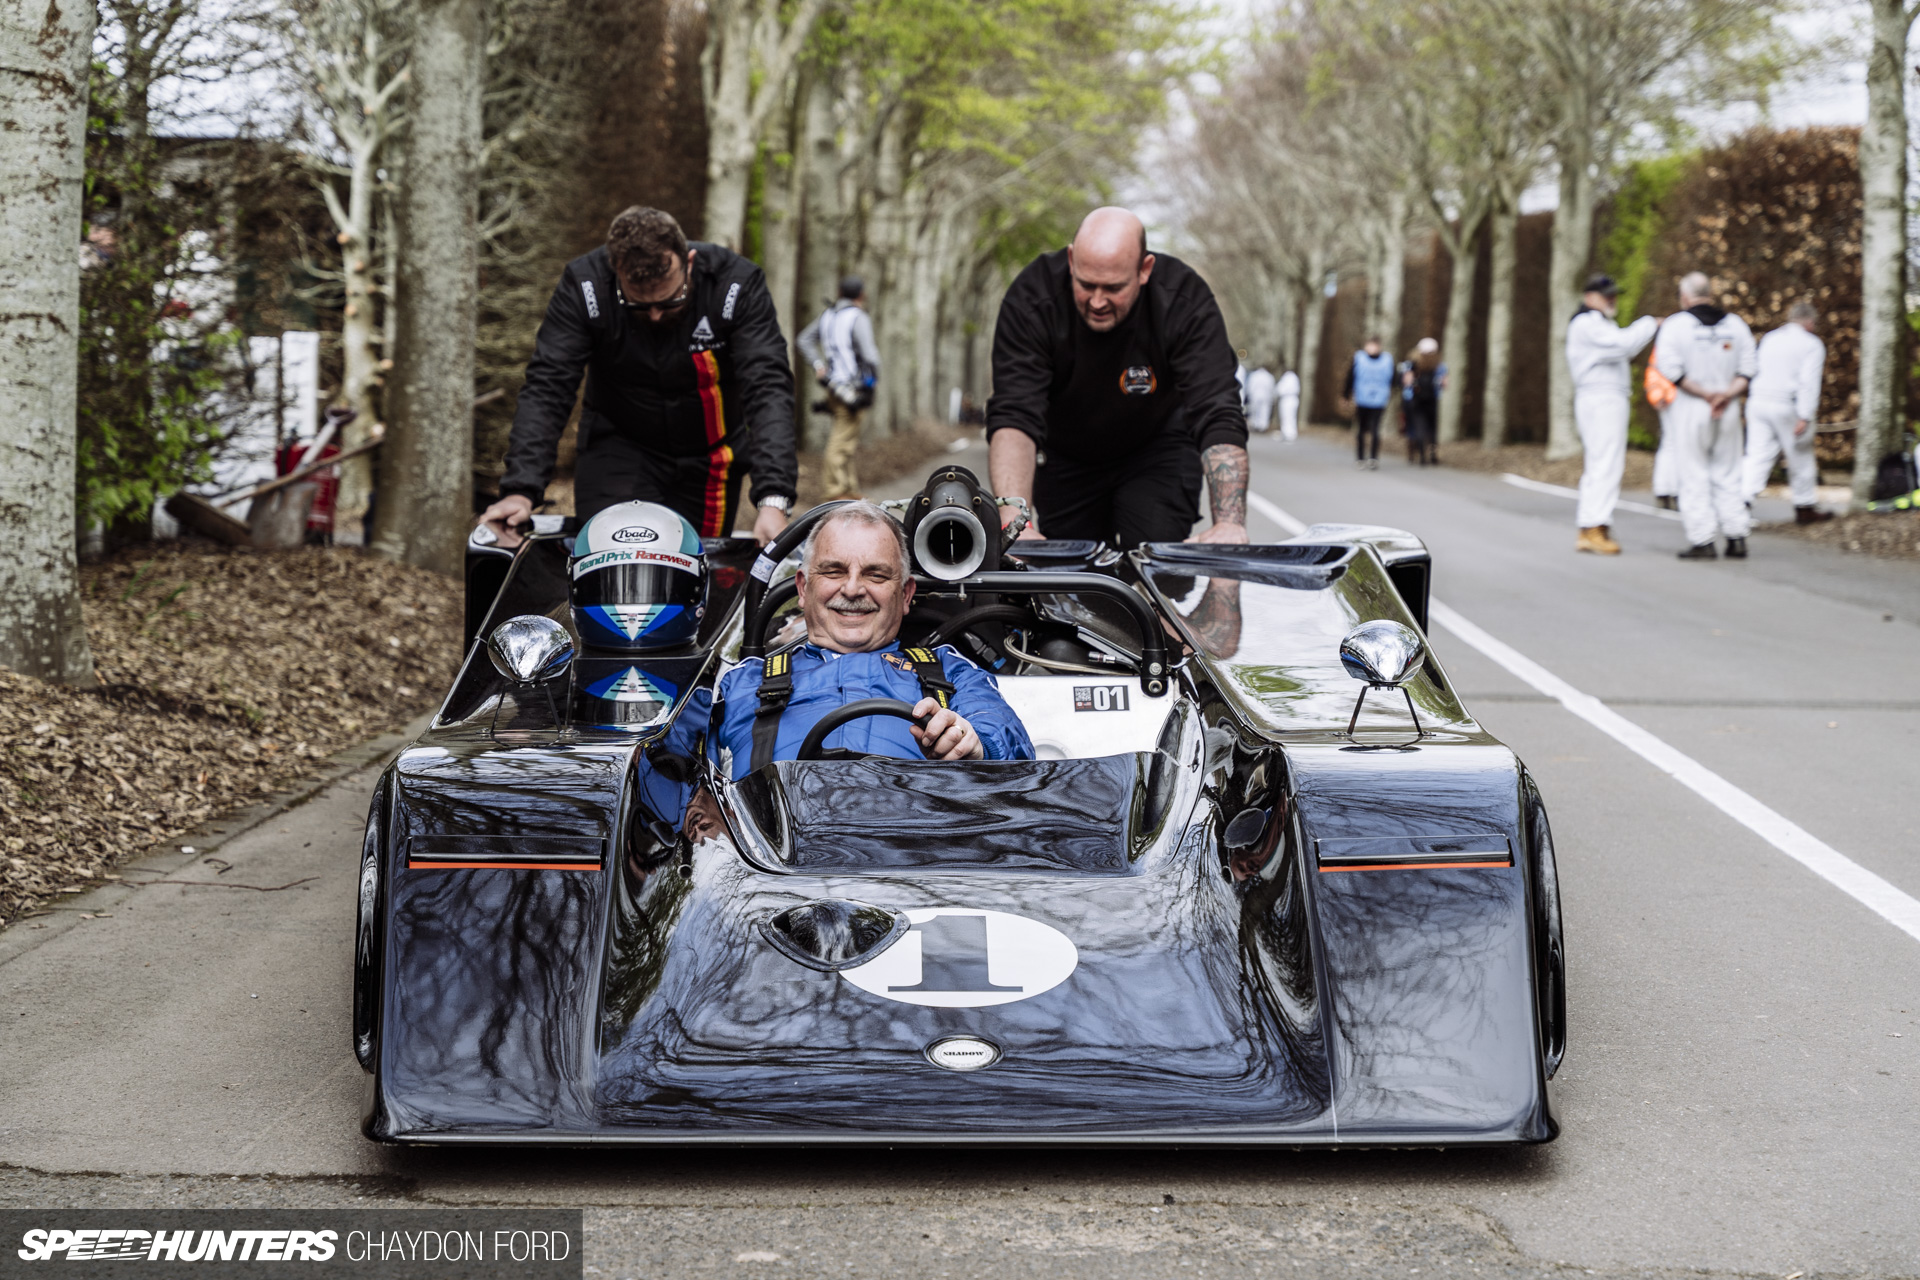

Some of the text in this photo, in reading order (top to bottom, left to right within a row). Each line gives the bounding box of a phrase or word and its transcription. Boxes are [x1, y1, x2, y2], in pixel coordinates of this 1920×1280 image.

[579, 550, 692, 572] Grand Prix Racewear
[1093, 686, 1125, 711] 01
[888, 914, 1024, 993] 1
